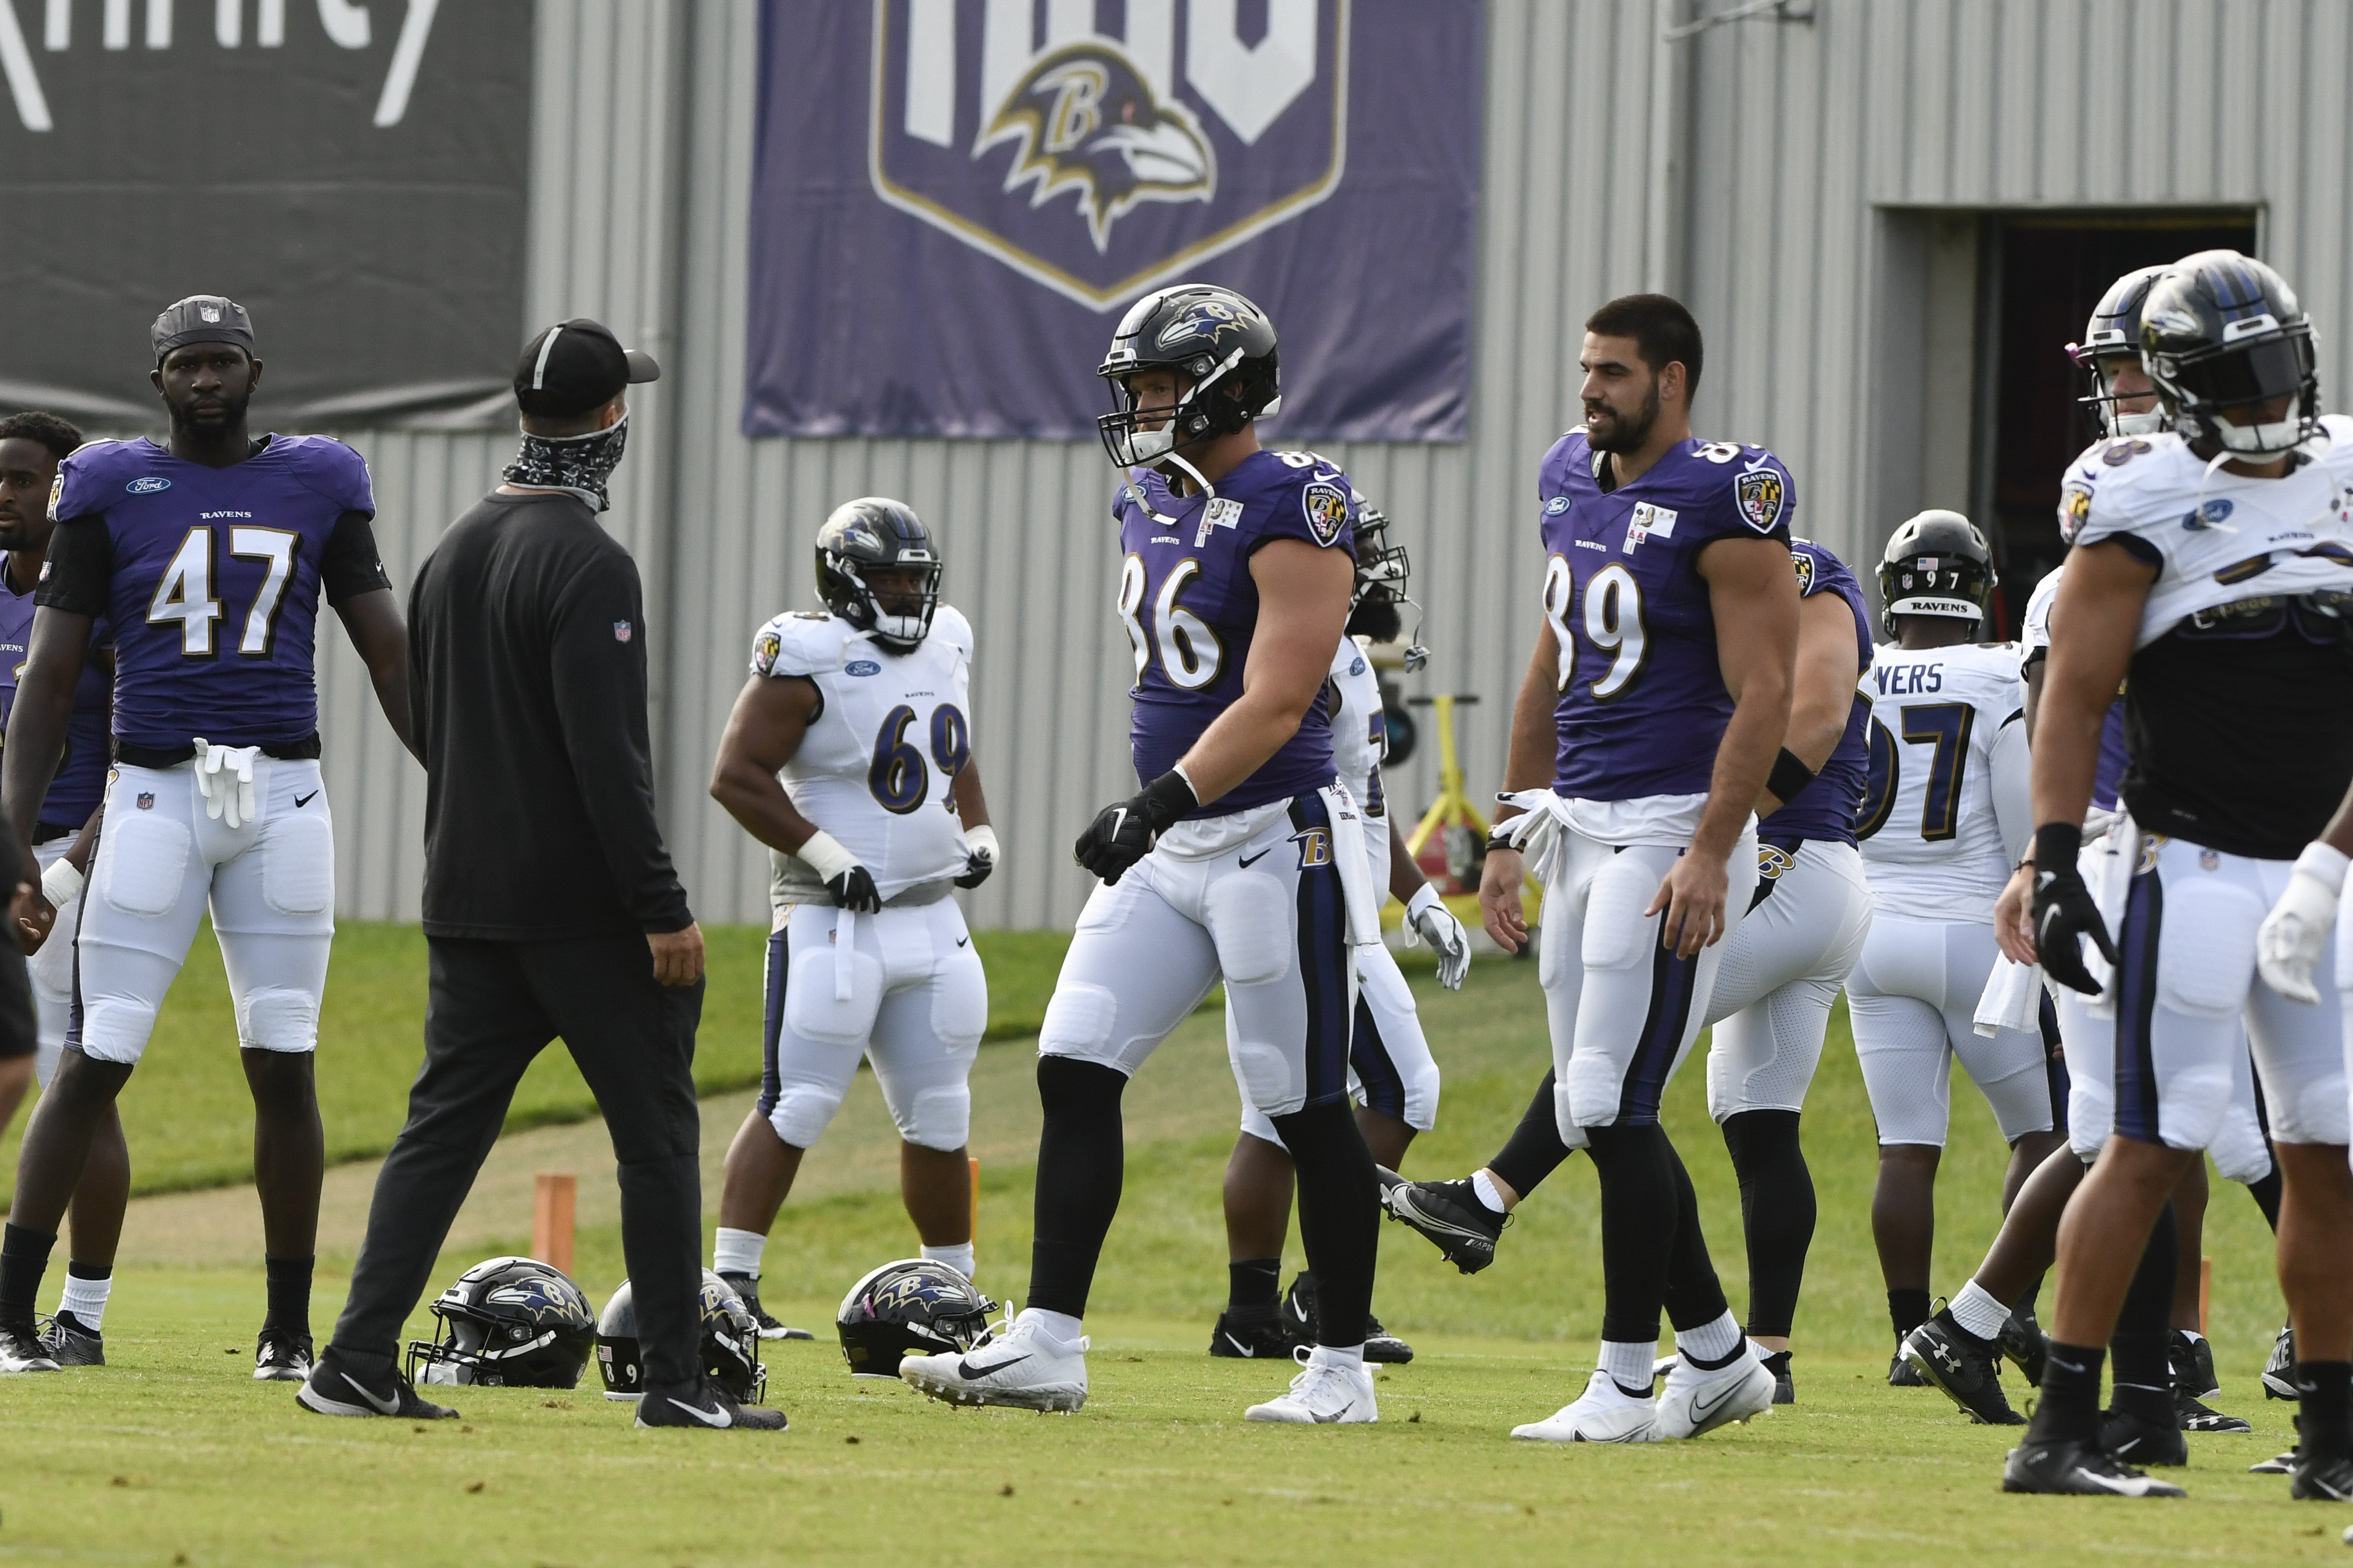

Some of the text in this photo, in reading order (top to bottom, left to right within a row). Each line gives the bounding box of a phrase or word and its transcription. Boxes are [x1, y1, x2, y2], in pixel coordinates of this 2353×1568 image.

[1741, 473, 1777, 484] RAVENS
[134, 479, 162, 491] Ford
[1310, 487, 1342, 501] RAVENS
[199, 511, 252, 519] RAVENS
[1151, 536, 1180, 545] RAVENS
[1575, 540, 1607, 552] RAVENS
[145, 525, 301, 657] 47
[1910, 602, 1968, 613] RAVENS
[1116, 552, 1223, 692] 86
[1542, 552, 1648, 698] 89
[0, 644, 23, 652] VENS
[869, 704, 970, 815] 69
[1289, 827, 1332, 870] B
